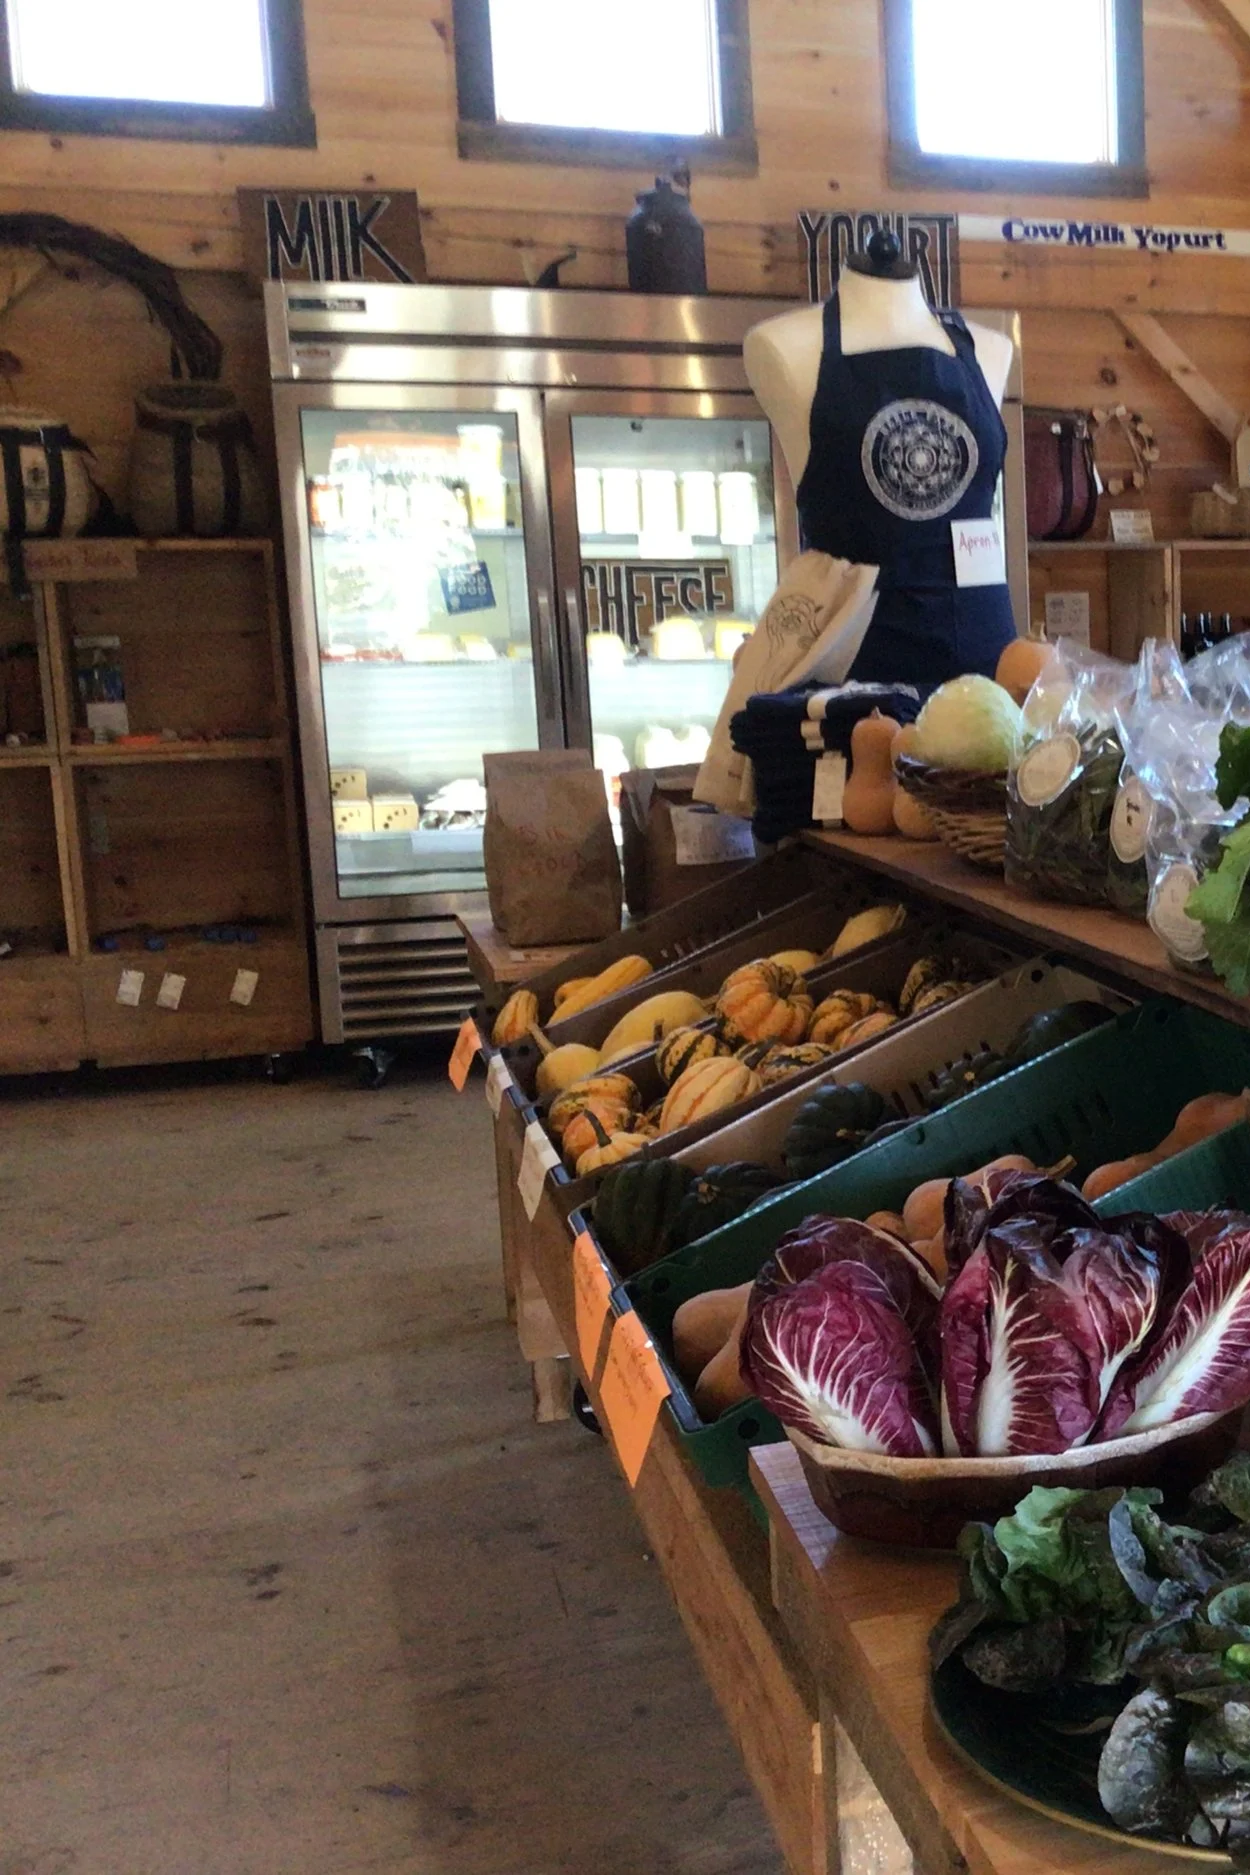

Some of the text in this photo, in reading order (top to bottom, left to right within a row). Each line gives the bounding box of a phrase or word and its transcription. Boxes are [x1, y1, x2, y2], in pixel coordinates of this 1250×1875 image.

[264, 194, 416, 283] MILK
[1001, 217, 1064, 242] Cow
[959, 530, 991, 557] Apron
